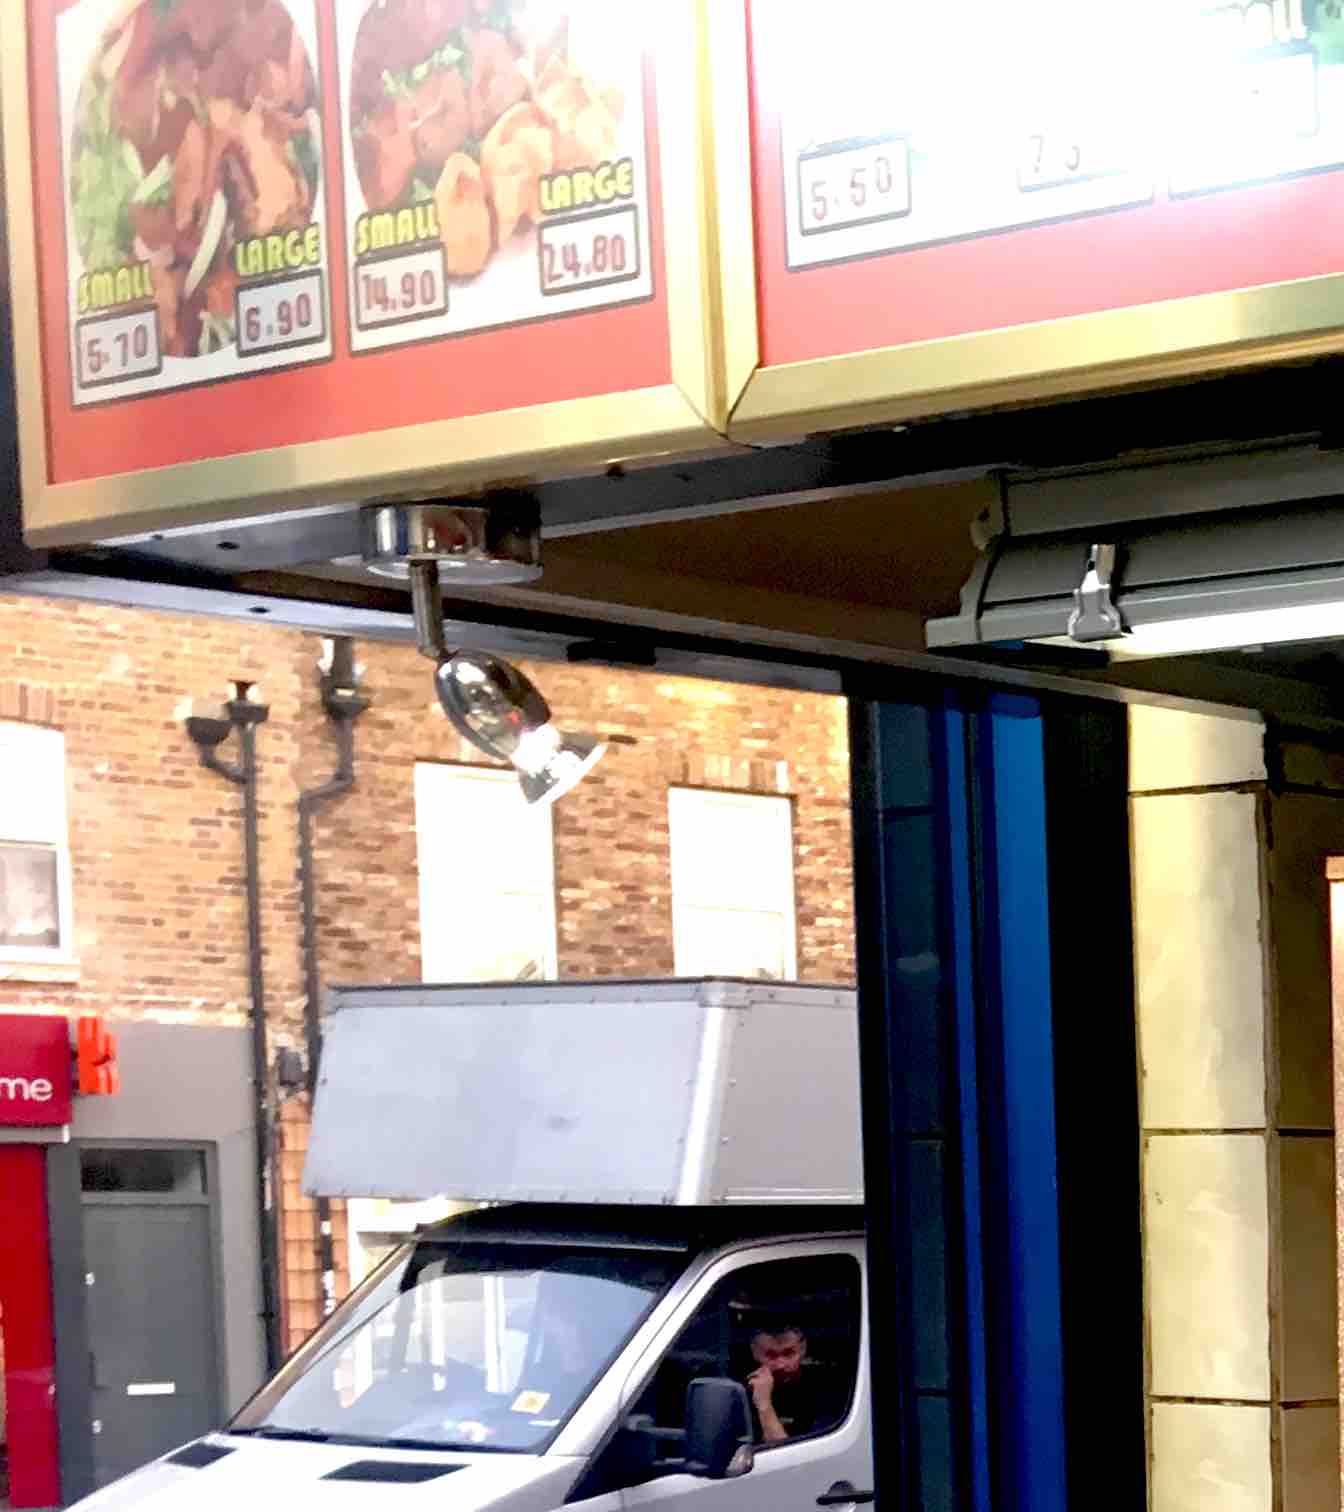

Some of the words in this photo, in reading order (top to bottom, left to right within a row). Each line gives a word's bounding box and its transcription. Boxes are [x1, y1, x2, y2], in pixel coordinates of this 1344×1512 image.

[539, 156, 634, 215] LARGE
[810, 156, 894, 221] 5.50
[236, 223, 320, 279] LARGE
[354, 198, 440, 257] SMALL
[78, 260, 152, 313] SMALL
[244, 293, 313, 342] 6.90
[86, 324, 150, 374] 5.70
